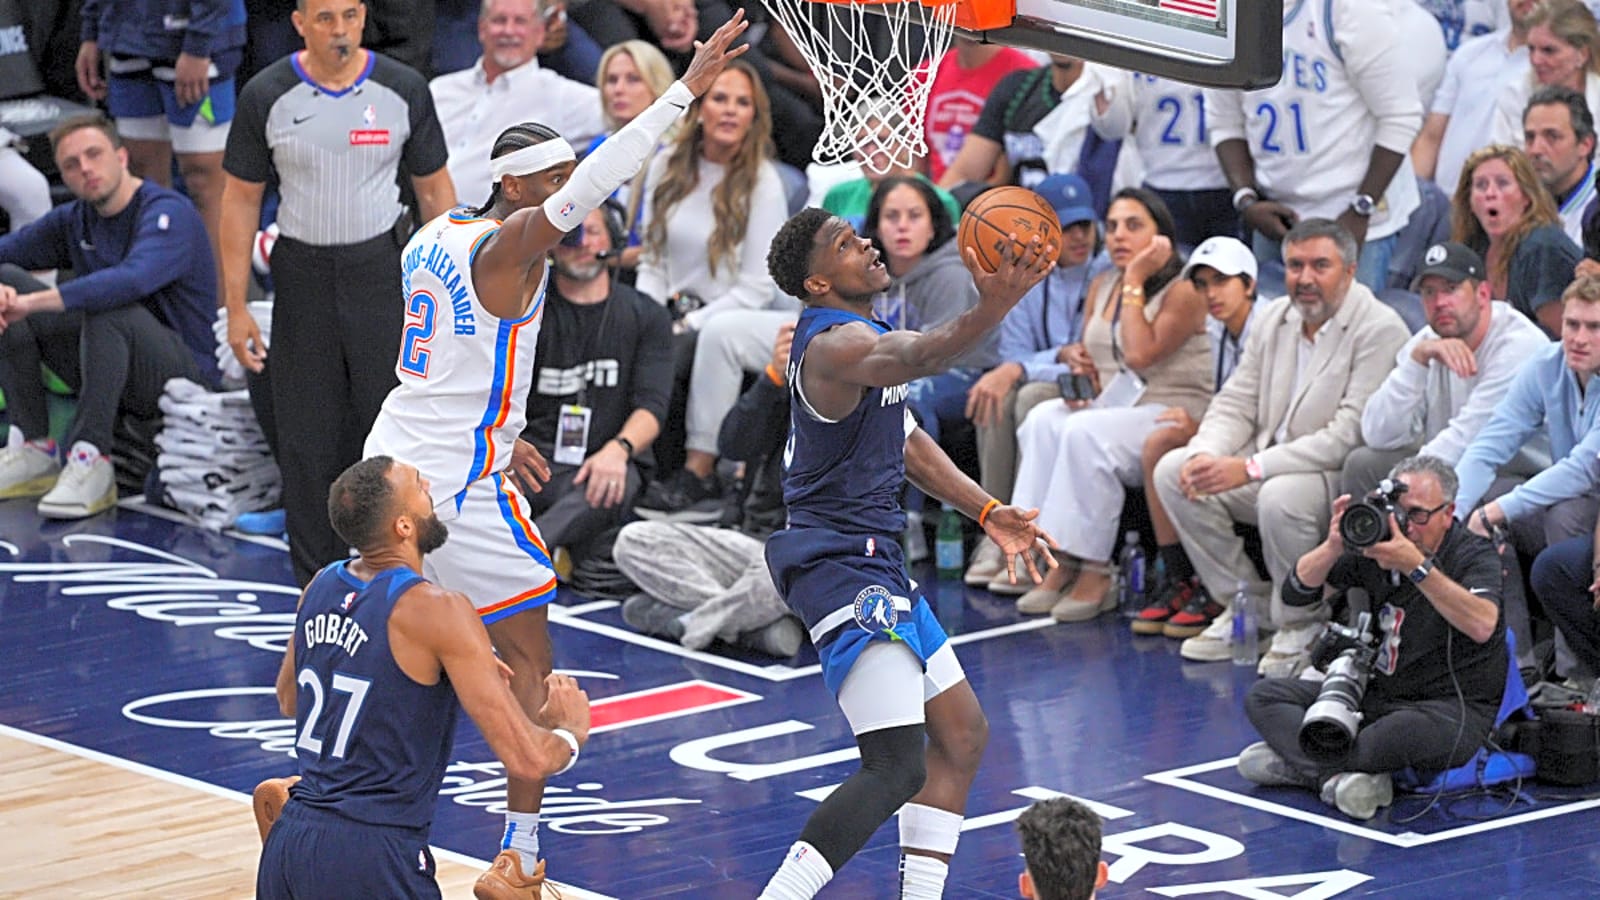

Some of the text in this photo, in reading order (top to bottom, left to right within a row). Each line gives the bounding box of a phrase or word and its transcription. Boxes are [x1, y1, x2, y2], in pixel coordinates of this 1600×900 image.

[1158, 93, 1206, 143] 21
[1257, 103, 1306, 152] 21
[400, 290, 438, 379] 2
[305, 613, 368, 658] GOBERT
[296, 668, 373, 759] 27
